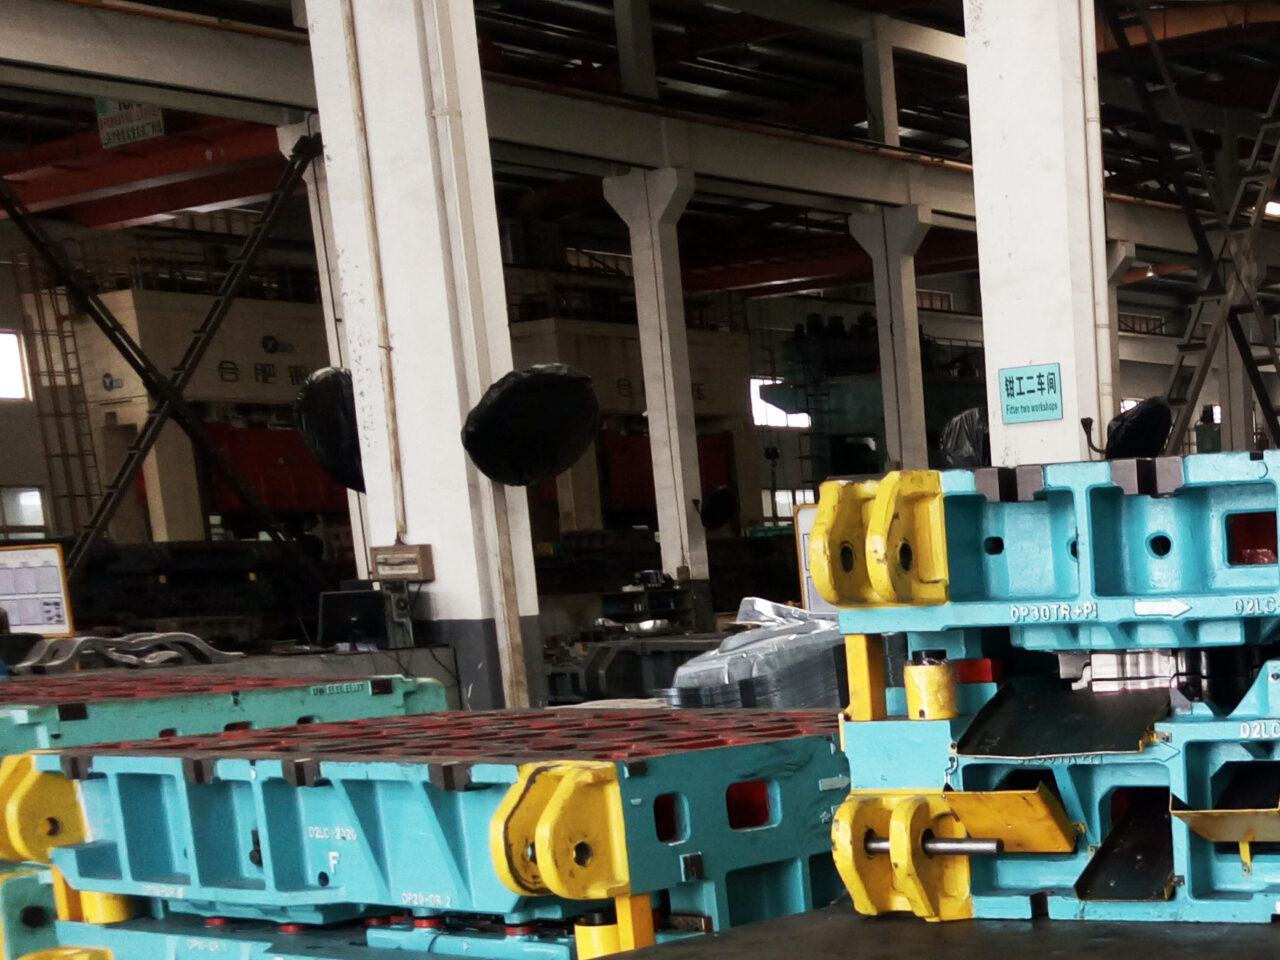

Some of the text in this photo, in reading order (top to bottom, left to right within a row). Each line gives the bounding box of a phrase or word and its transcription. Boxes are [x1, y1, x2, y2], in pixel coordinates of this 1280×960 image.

[1005, 372, 1057, 398] 钳工二车间
[1006, 401, 1058, 415] Fitter two workshops
[328, 851, 341, 874] F
